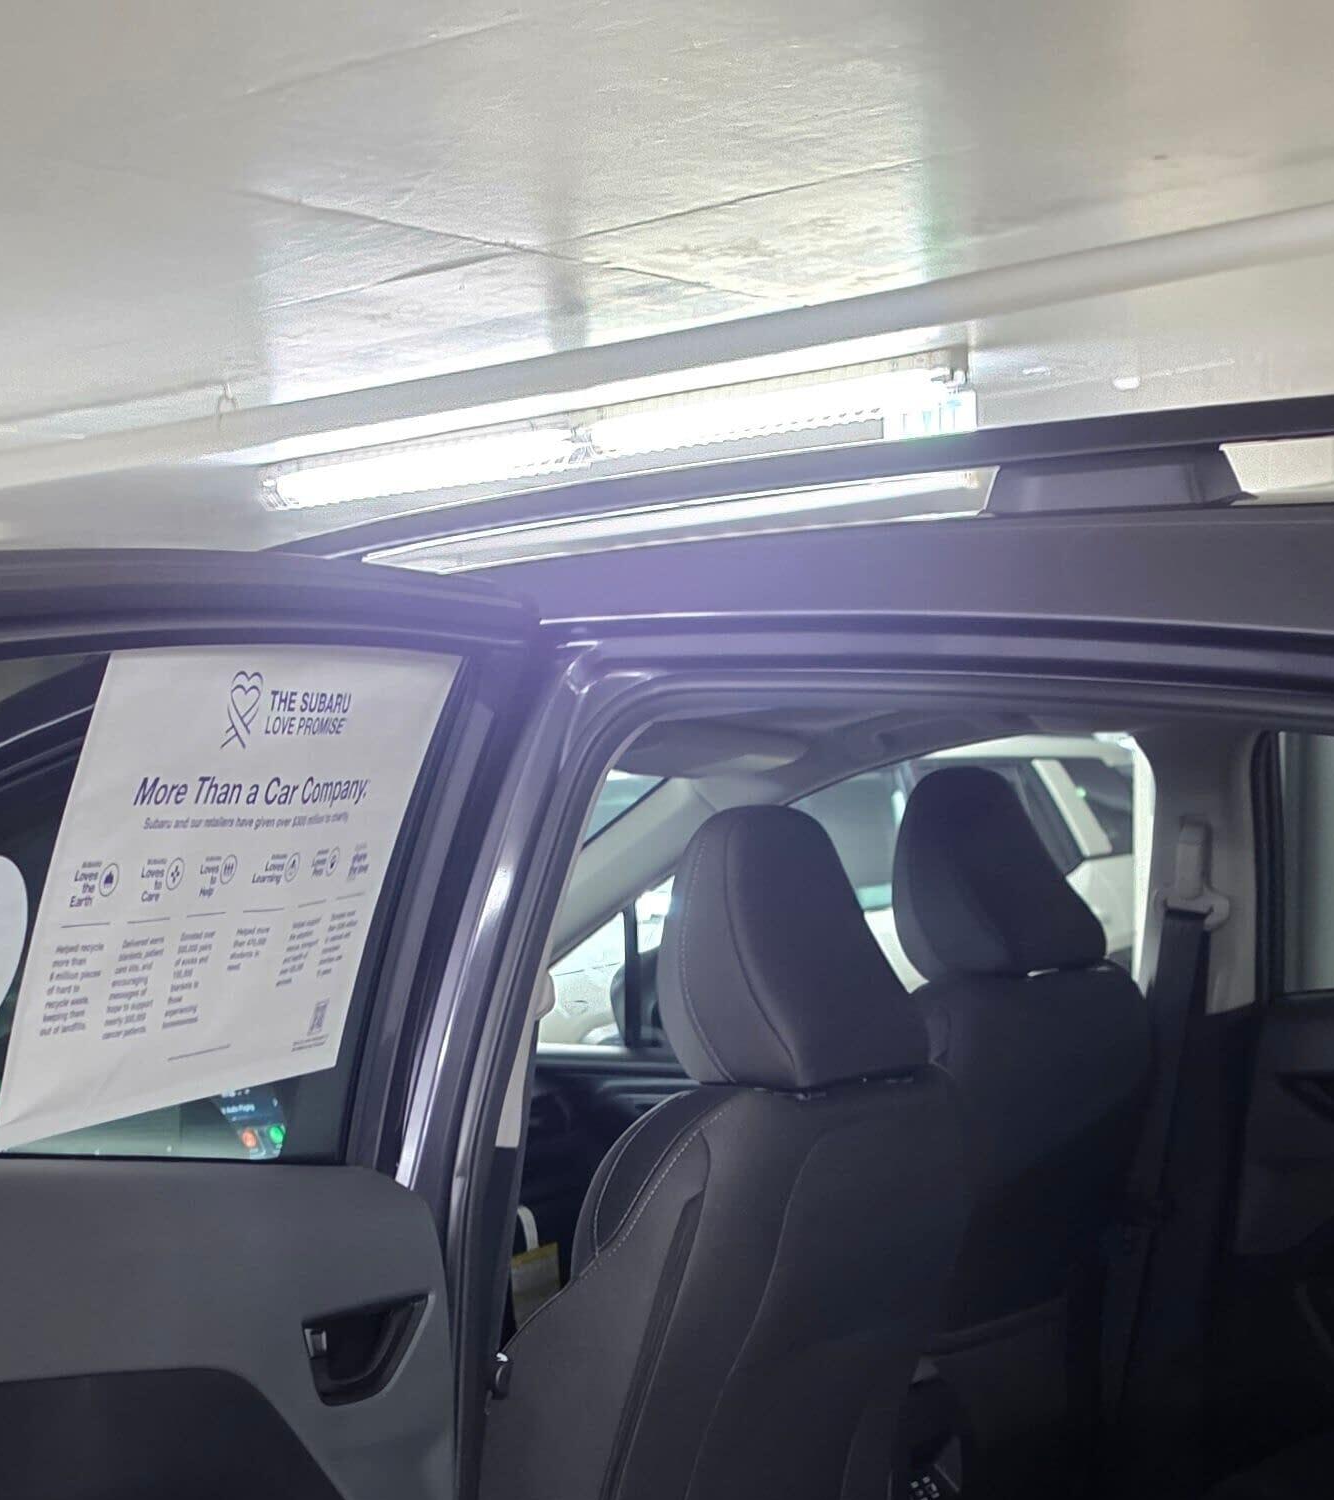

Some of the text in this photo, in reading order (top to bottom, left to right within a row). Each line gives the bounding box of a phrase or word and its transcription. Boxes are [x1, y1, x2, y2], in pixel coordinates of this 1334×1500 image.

[270, 690, 352, 714] THE SUBARU
[265, 716, 294, 735] LOVE
[133, 777, 188, 806] More
[194, 776, 243, 805] Than
[246, 783, 259, 805] a
[264, 777, 299, 806] Car
[143, 817, 173, 830] Subaru
[174, 817, 189, 829] and
[235, 817, 253, 828] have
[254, 817, 275, 830] given
[276, 818, 291, 828] over
[200, 864, 219, 875] Loves
[265, 861, 285, 872] Loves
[74, 870, 99, 882] Loves
[141, 867, 164, 879] Loves
[252, 873, 283, 885] Learning
[154, 880, 163, 890] to
[209, 875, 217, 885] to
[82, 883, 96, 894] the
[69, 896, 93, 908] Earth
[141, 891, 160, 903] Care
[81, 943, 104, 954] recycle
